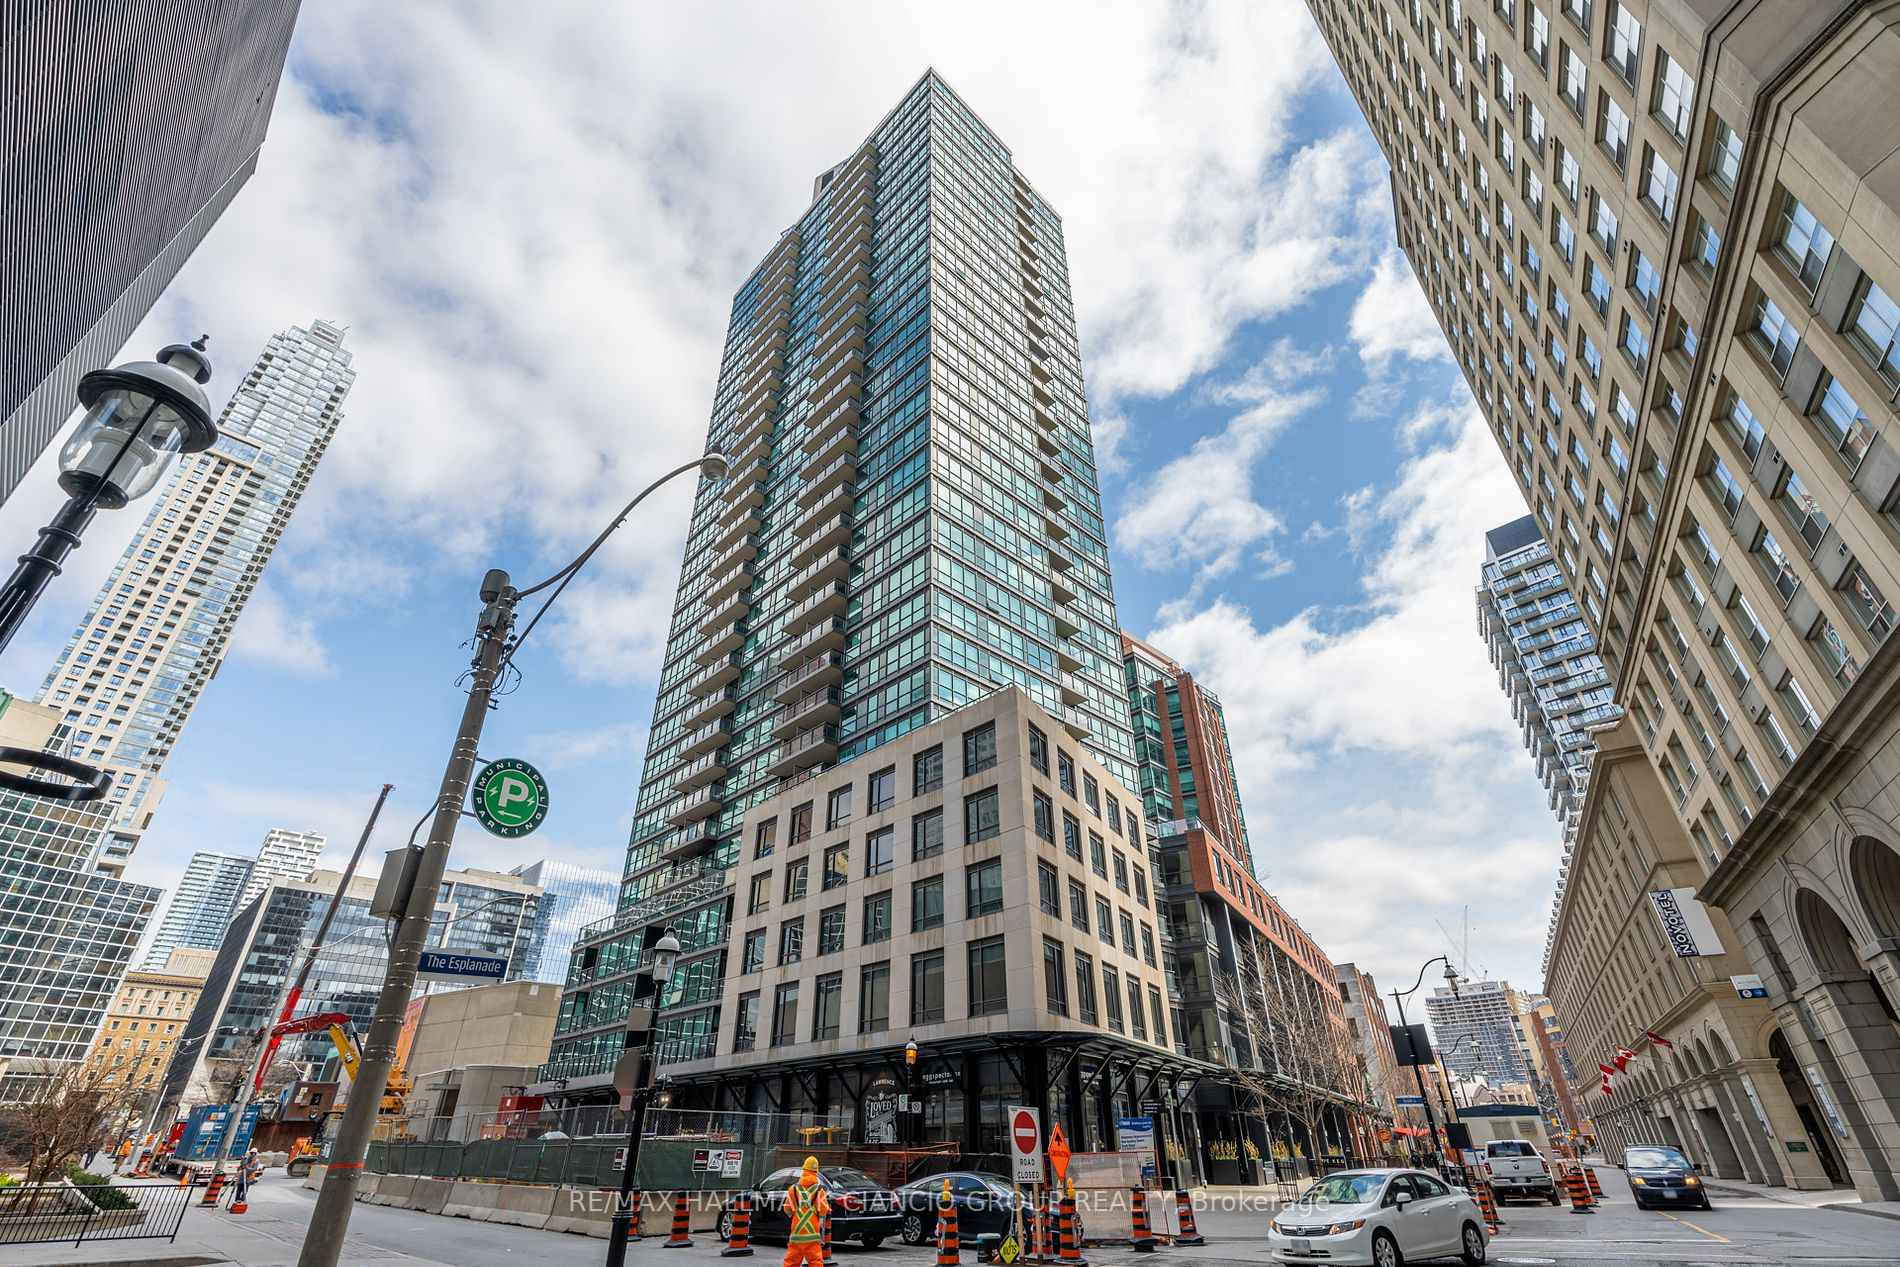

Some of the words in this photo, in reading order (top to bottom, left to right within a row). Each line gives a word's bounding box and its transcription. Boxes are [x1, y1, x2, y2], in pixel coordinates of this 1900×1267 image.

[479, 762, 545, 803] MUNICIPAL
[498, 777, 529, 808] P
[476, 797, 542, 835] PARKING
[1659, 892, 1692, 955] NOVOTEL
[427, 954, 446, 969] The
[448, 956, 501, 973] Esplanade
[872, 1079, 895, 1087] LAWRENCE
[922, 1071, 960, 1081] eggspectan
[870, 1101, 892, 1119] LOVED
[1019, 1158, 1036, 1166] ROAD
[1016, 1171, 1040, 1179] CLOSED
